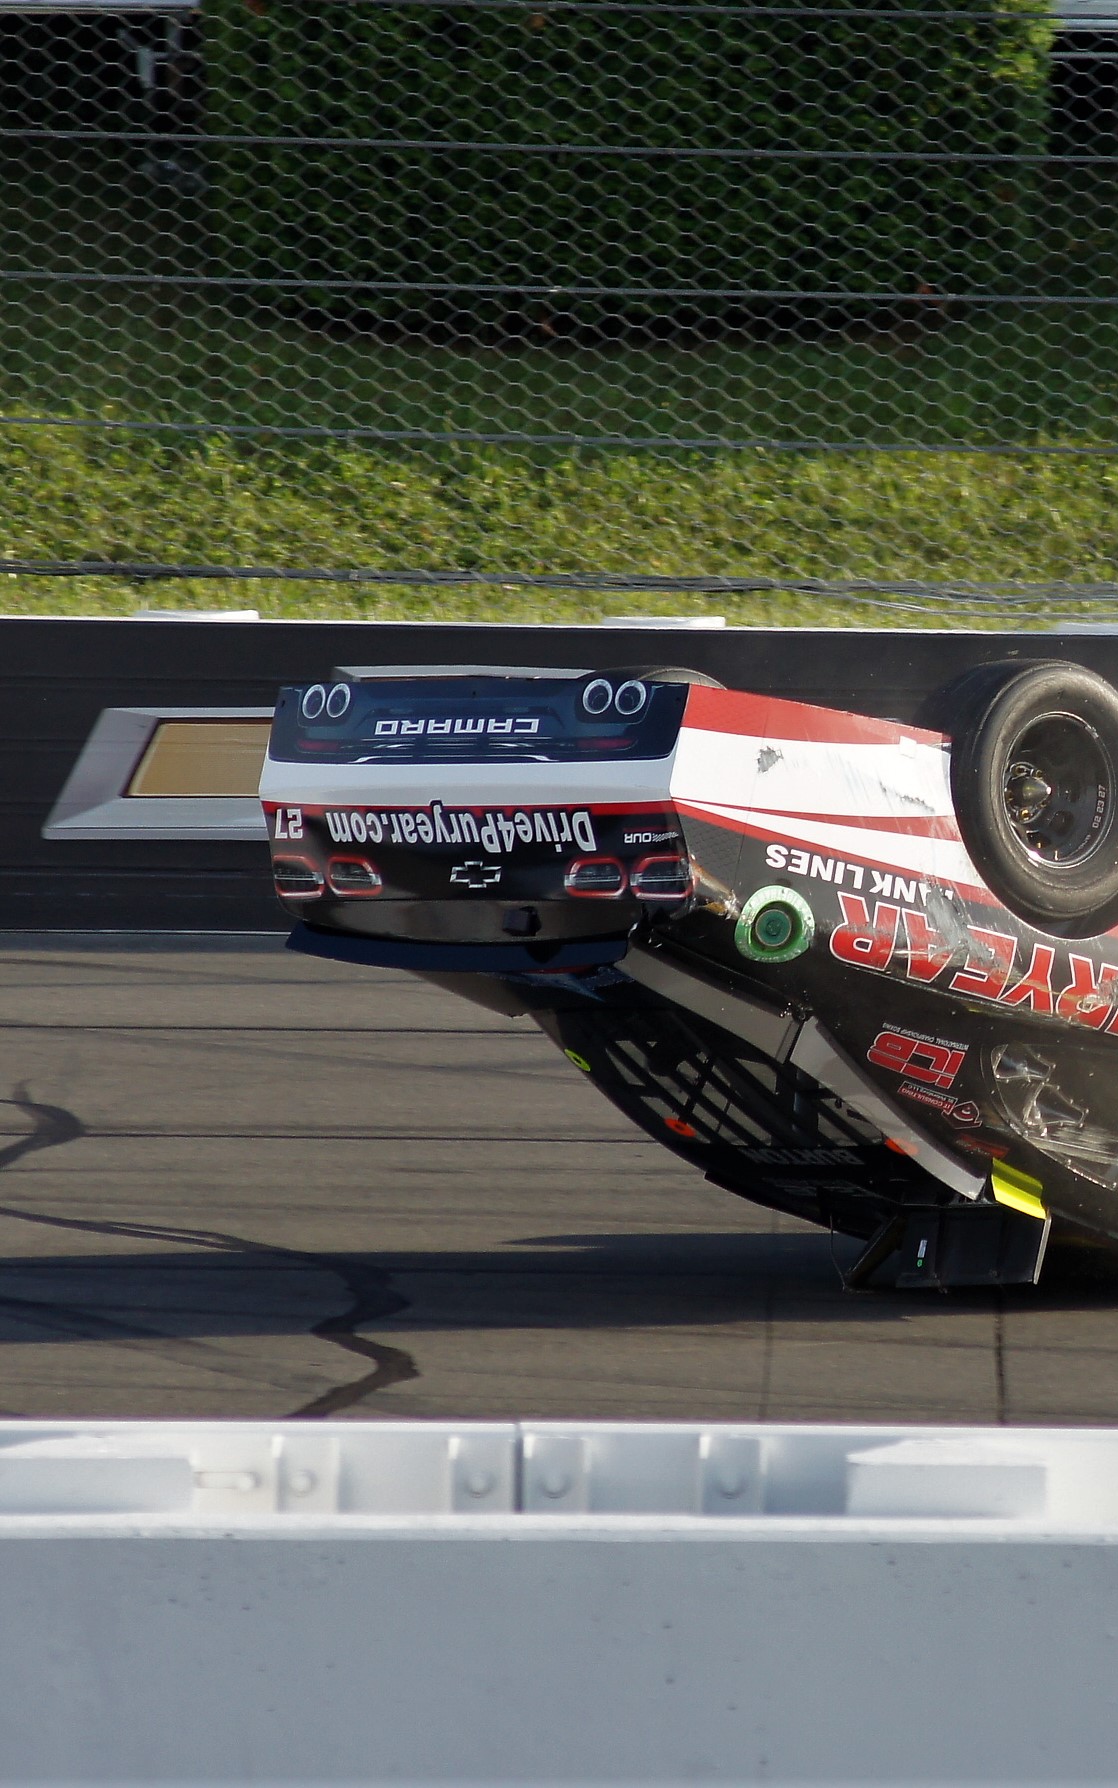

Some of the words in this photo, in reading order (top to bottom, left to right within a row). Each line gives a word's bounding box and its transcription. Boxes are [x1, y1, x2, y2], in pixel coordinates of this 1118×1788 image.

[374, 718, 540, 736] CAMARO
[274, 808, 303, 839] 27
[325, 804, 597, 853] Drive4Puryear.com
[765, 844, 864, 890] LINES
